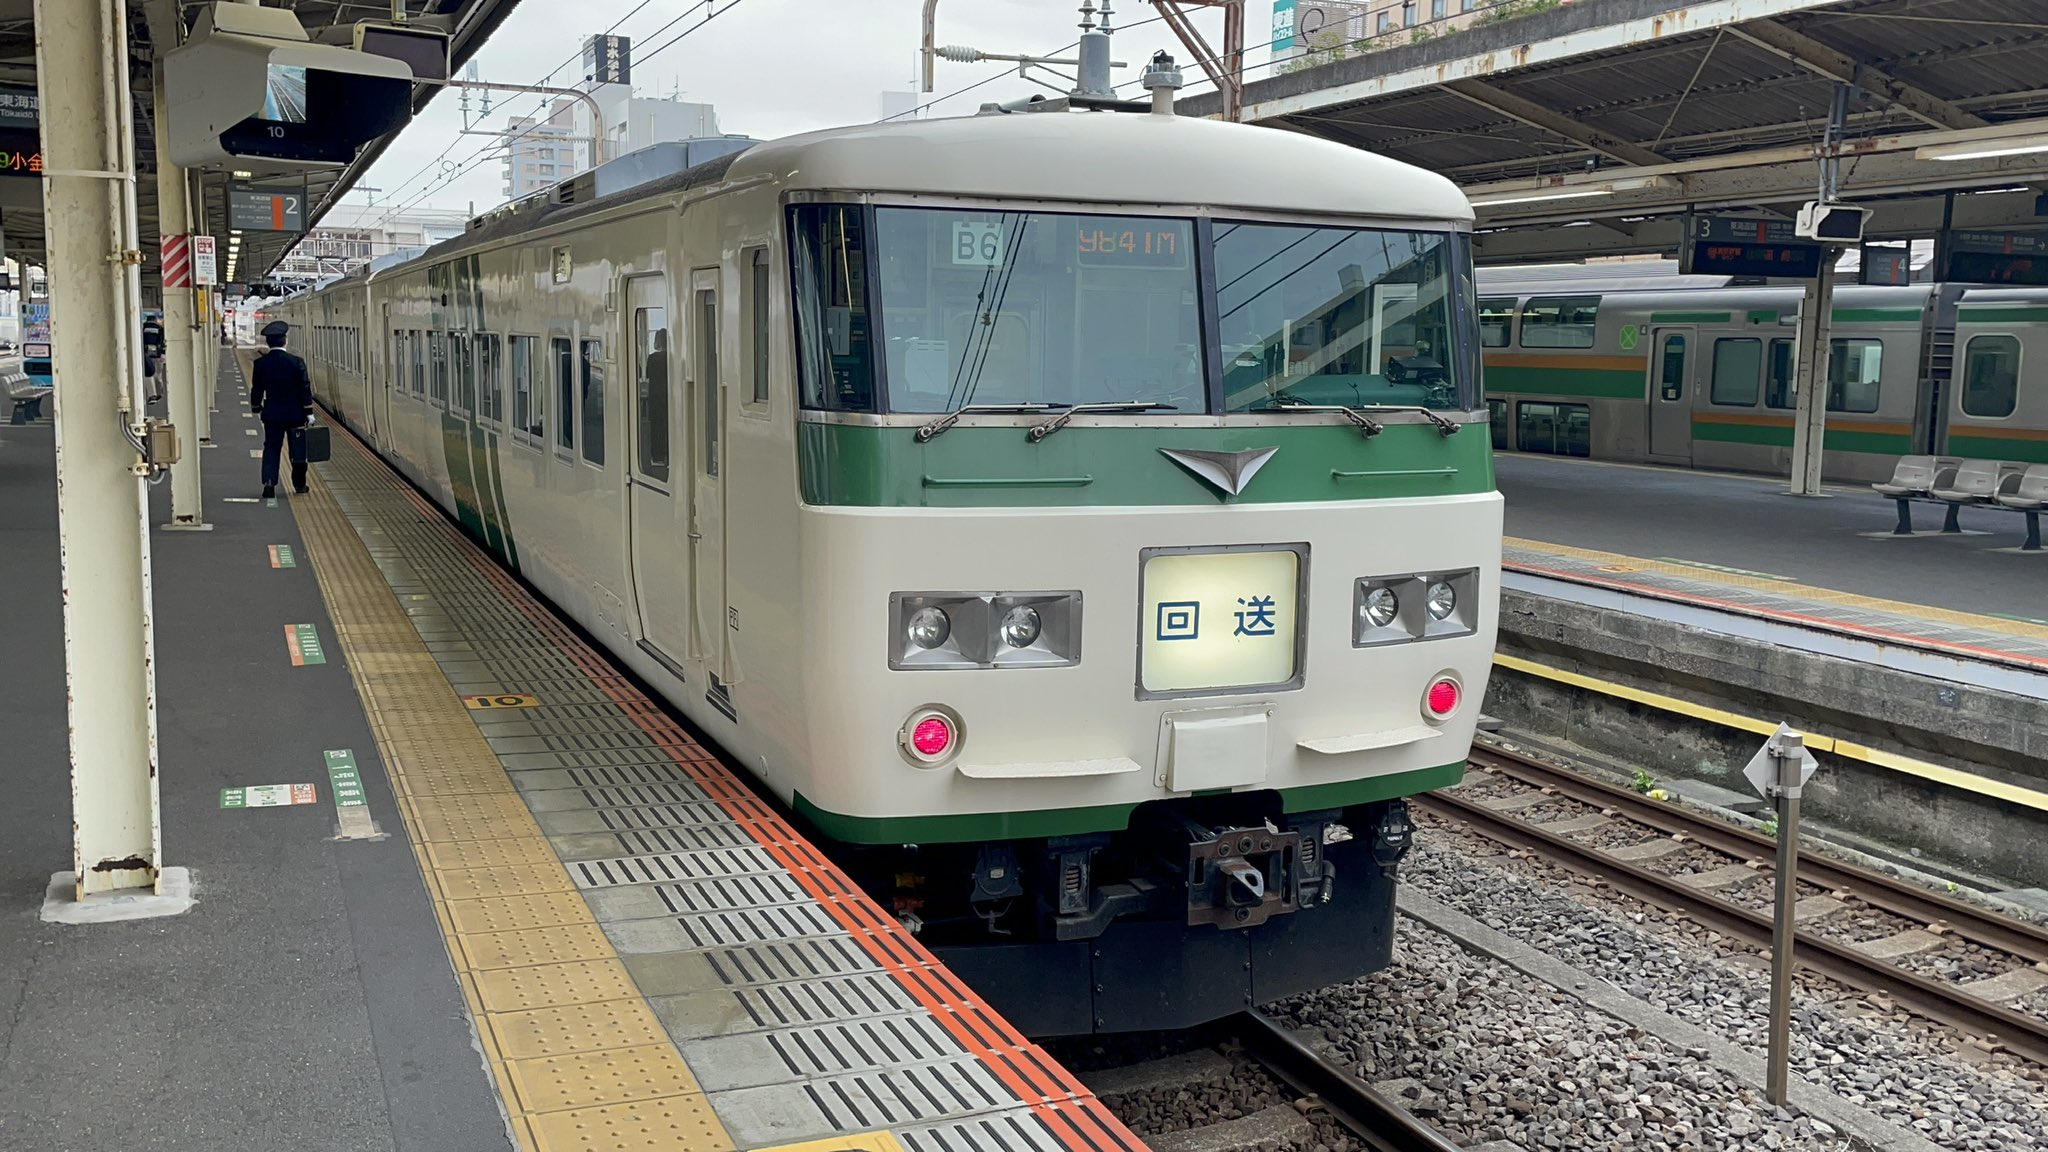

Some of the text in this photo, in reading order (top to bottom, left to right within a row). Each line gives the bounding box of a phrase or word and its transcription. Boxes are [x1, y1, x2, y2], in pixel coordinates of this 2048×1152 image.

[267, 126, 285, 138] 10
[285, 196, 298, 215] 2
[1701, 219, 1711, 237] 3
[957, 231, 999, 260] B6
[1898, 257, 1906, 272] 4
[1156, 595, 1276, 641] 回送
[477, 696, 524, 706] 10
